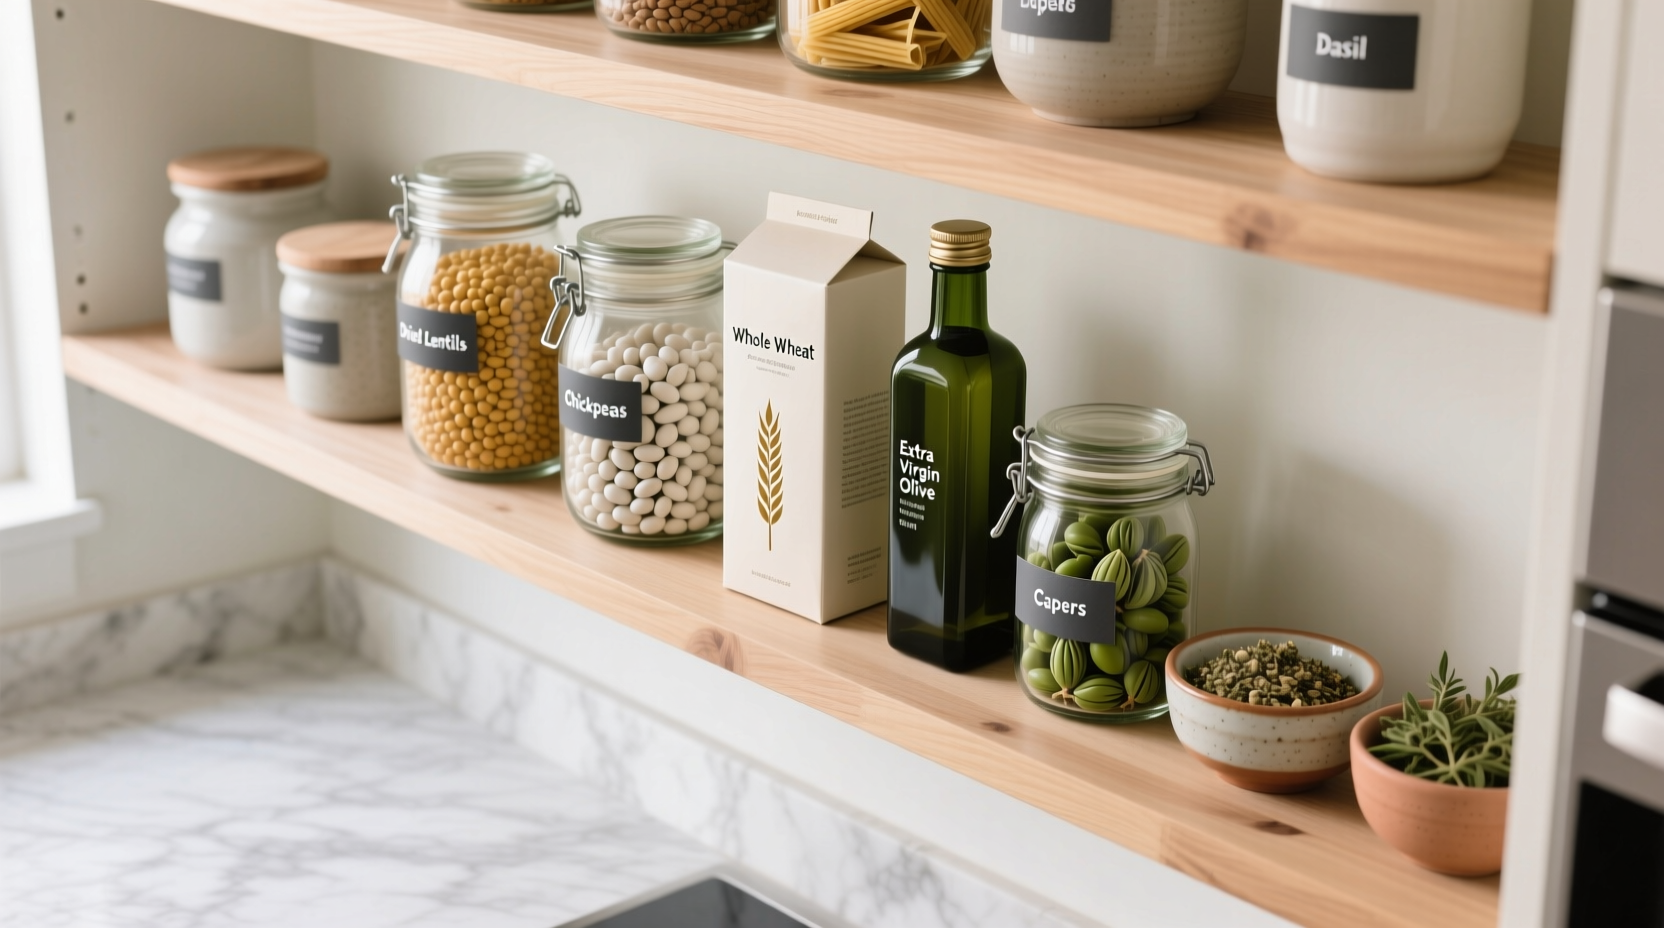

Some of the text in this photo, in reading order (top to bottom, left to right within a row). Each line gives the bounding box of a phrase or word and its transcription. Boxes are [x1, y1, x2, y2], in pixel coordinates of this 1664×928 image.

[424, 330, 468, 352] Lentils
[732, 326, 815, 360] Whole Wheat
[564, 389, 628, 419] Chickpeas
[900, 439, 934, 463] Extra
[900, 458, 940, 483] Virgin
[900, 477, 936, 500] Olive
[1033, 588, 1087, 617] Capers
